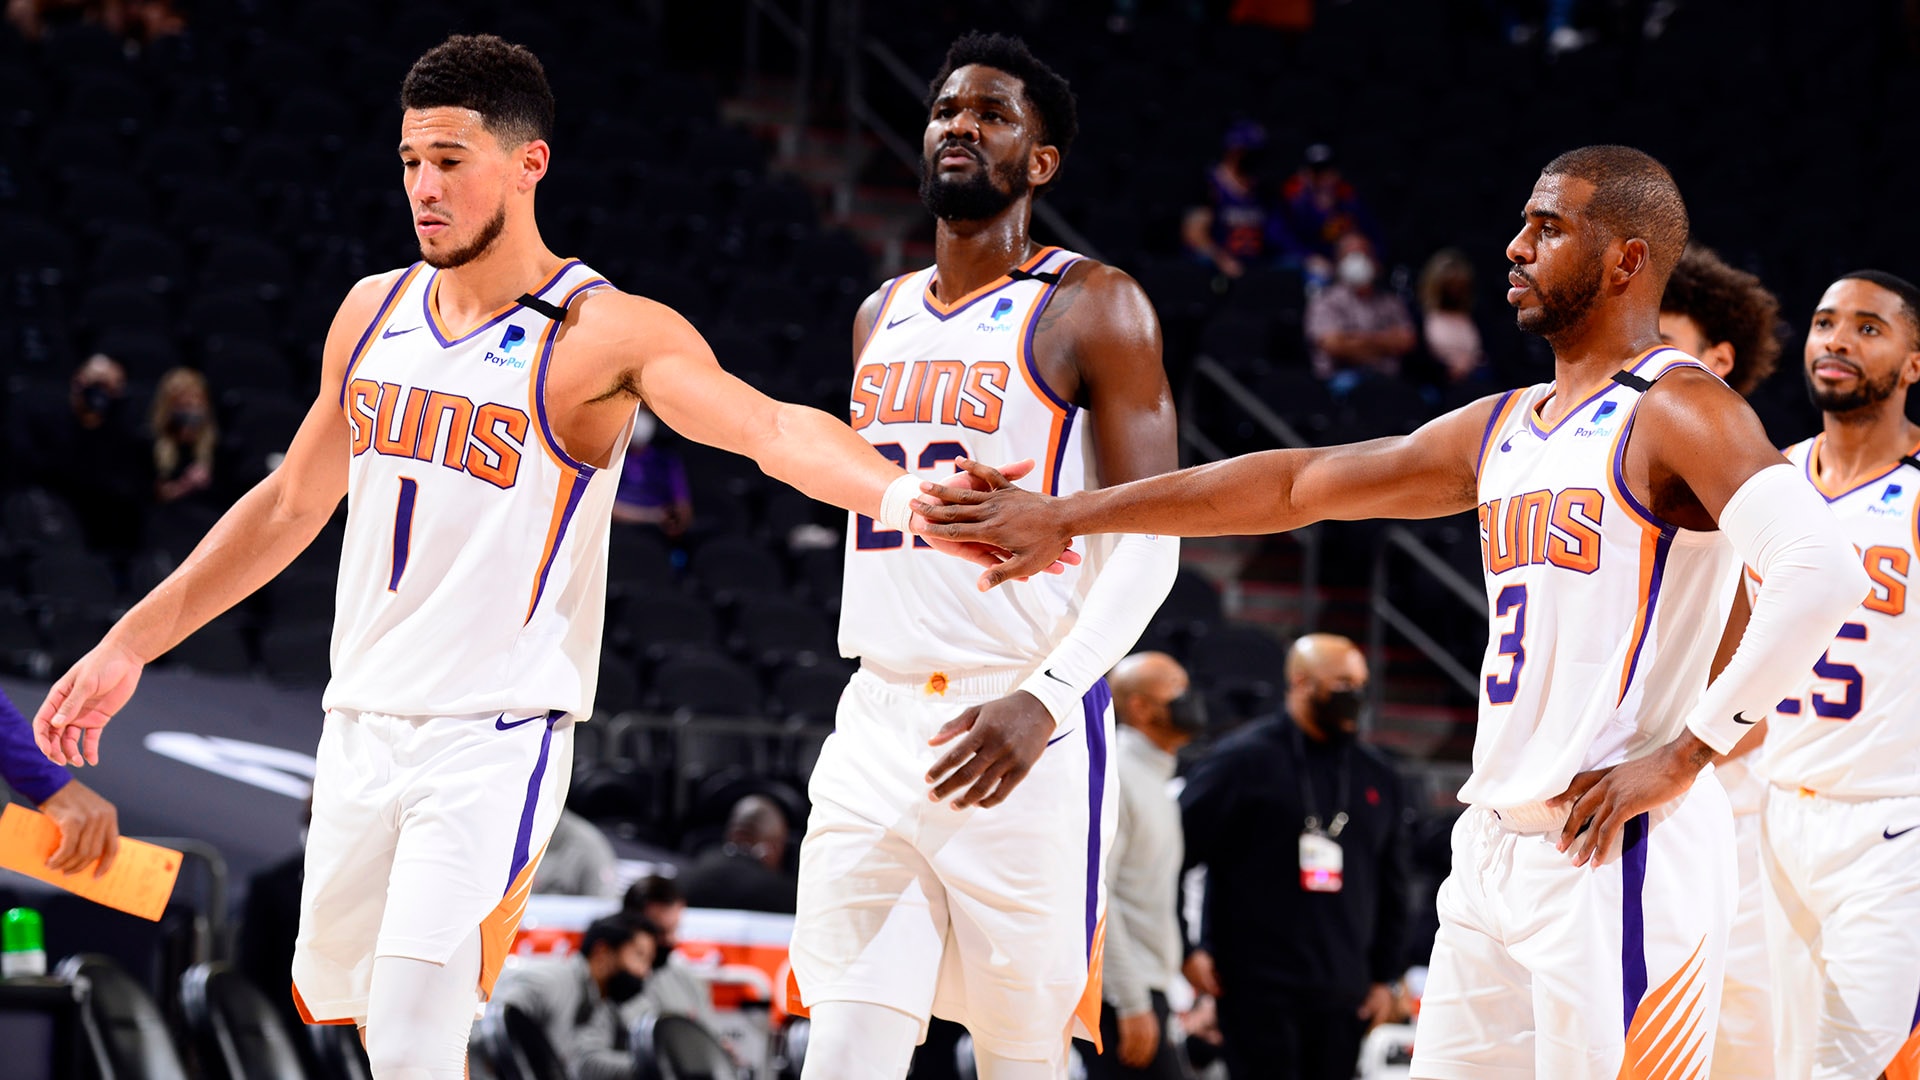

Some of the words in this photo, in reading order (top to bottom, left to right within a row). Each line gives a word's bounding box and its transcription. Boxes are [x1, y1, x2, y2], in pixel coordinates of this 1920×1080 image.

[484, 352, 526, 369] PayPal
[850, 360, 1011, 434] SUNS
[349, 378, 530, 490] SUNS
[388, 475, 418, 593] 1
[1484, 582, 1529, 707] 3
